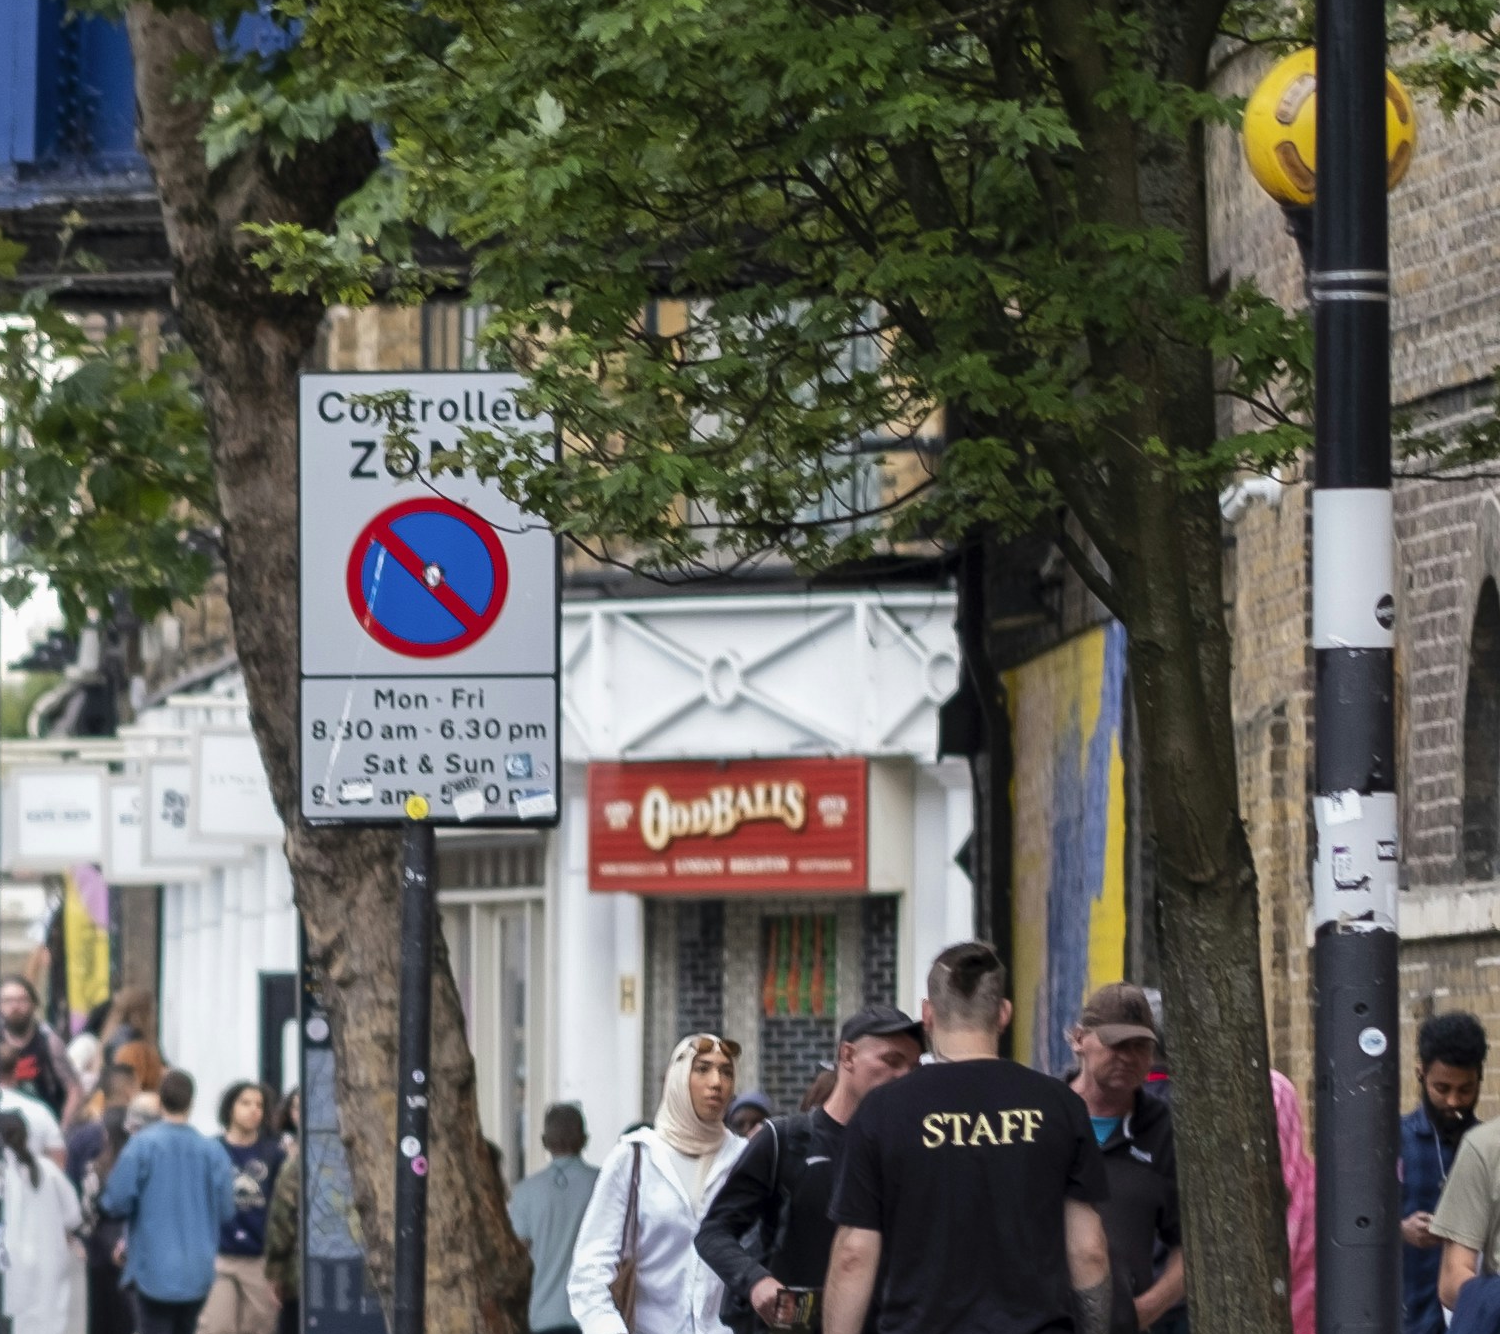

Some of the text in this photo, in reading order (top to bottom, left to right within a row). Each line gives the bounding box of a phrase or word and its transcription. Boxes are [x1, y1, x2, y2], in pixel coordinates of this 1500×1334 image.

[318, 389, 540, 424] Cotrolle
[350, 440, 468, 479] ZON
[373, 688, 430, 710] Mon
[452, 687, 485, 710] Fri
[311, 719, 374, 741] 8.30
[380, 724, 418, 740] am
[440, 718, 502, 741] 6.30
[508, 723, 547, 743] pm
[363, 753, 496, 775] Sat & Sun
[922, 1109, 1044, 1149] STAFF
